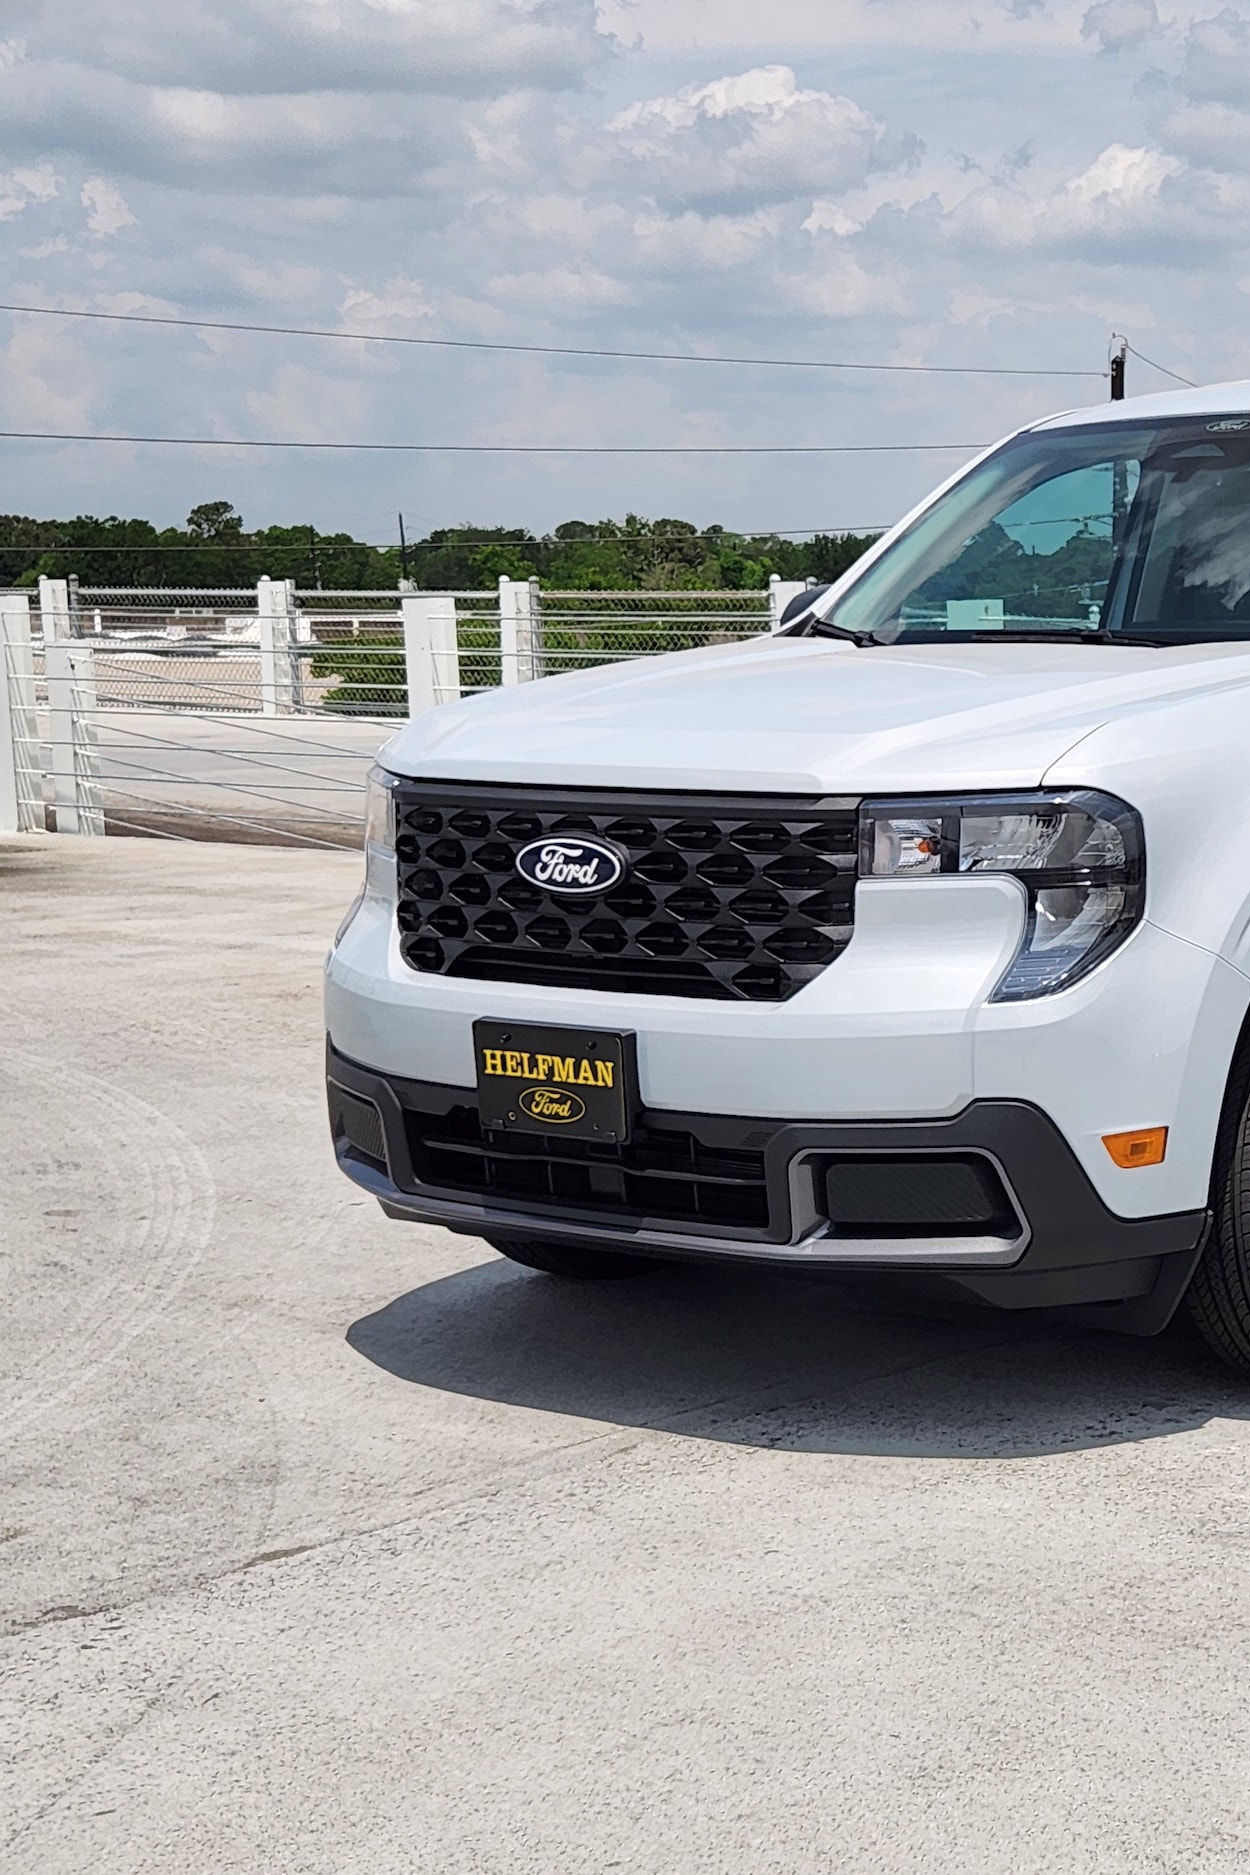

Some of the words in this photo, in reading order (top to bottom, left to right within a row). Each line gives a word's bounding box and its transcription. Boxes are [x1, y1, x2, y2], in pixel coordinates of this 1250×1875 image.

[534, 845, 599, 885] Ford
[482, 1049, 615, 1088] HELFMAN
[530, 1090, 573, 1118] Ford
